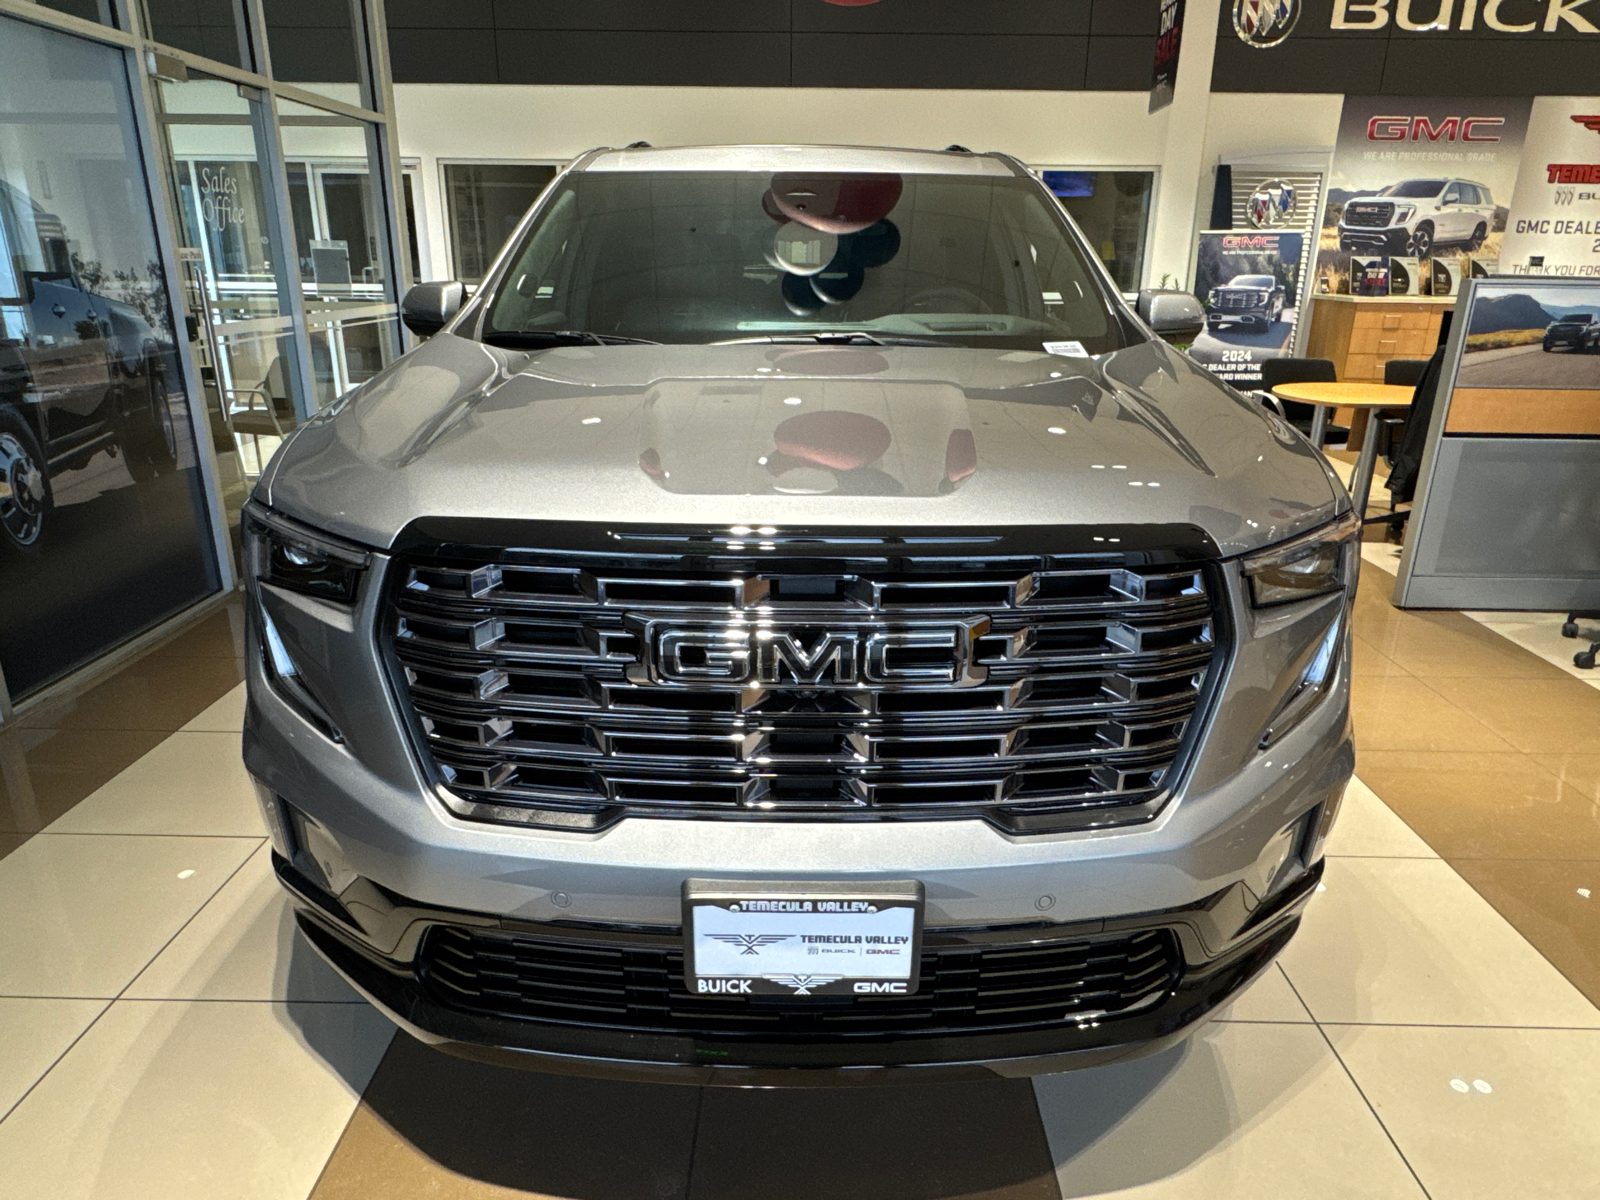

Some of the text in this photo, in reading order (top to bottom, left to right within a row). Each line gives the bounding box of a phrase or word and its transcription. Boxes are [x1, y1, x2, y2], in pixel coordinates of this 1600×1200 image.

[1330, 0, 1600, 33] BUICK
[1367, 115, 1505, 143] GMC
[1363, 151, 1497, 162] WE ARE PROFESSIONAL GRADE
[201, 166, 237, 195] Sales
[202, 195, 245, 232] Office
[1516, 220, 1550, 234] GMC
[1222, 235, 1280, 248] GMC
[1554, 265, 1576, 276] YOU
[1579, 265, 1600, 276] FOR
[1222, 350, 1252, 361] 2024
[1208, 363, 1236, 371] DEALER
[1237, 363, 1247, 371] OF
[1247, 363, 1261, 371] THE
[1234, 373, 1263, 381] WINNER
[658, 628, 957, 684] GMC
[739, 900, 869, 912] TEMECULA VALLEY
[800, 934, 909, 945] TEMECULA VALLEY
[697, 979, 908, 993] BUICK GMC
